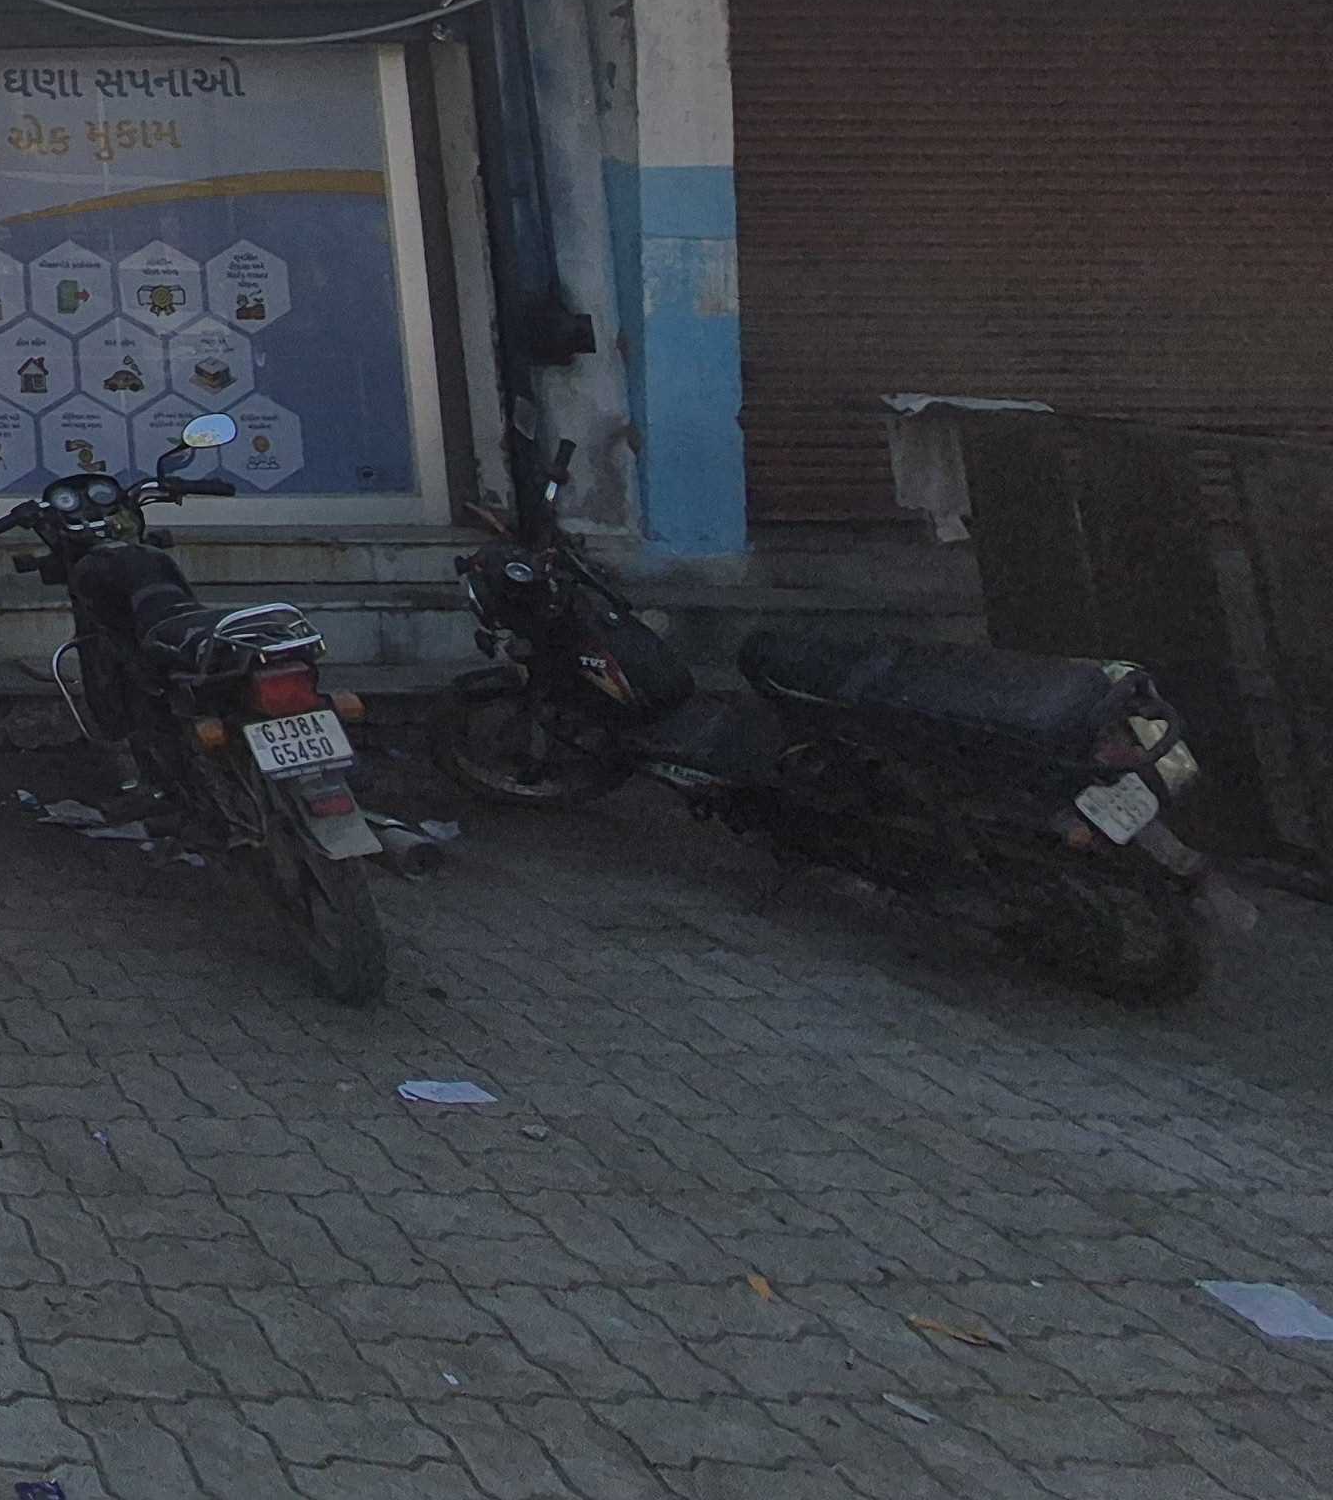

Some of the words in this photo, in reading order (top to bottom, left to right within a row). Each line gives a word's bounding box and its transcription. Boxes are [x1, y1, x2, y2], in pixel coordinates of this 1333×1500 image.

[3, 67, 84, 100] ઘણા
[93, 55, 247, 98] સપનાઓ
[261, 713, 325, 744] GJ38A
[271, 736, 335, 765] G5450
